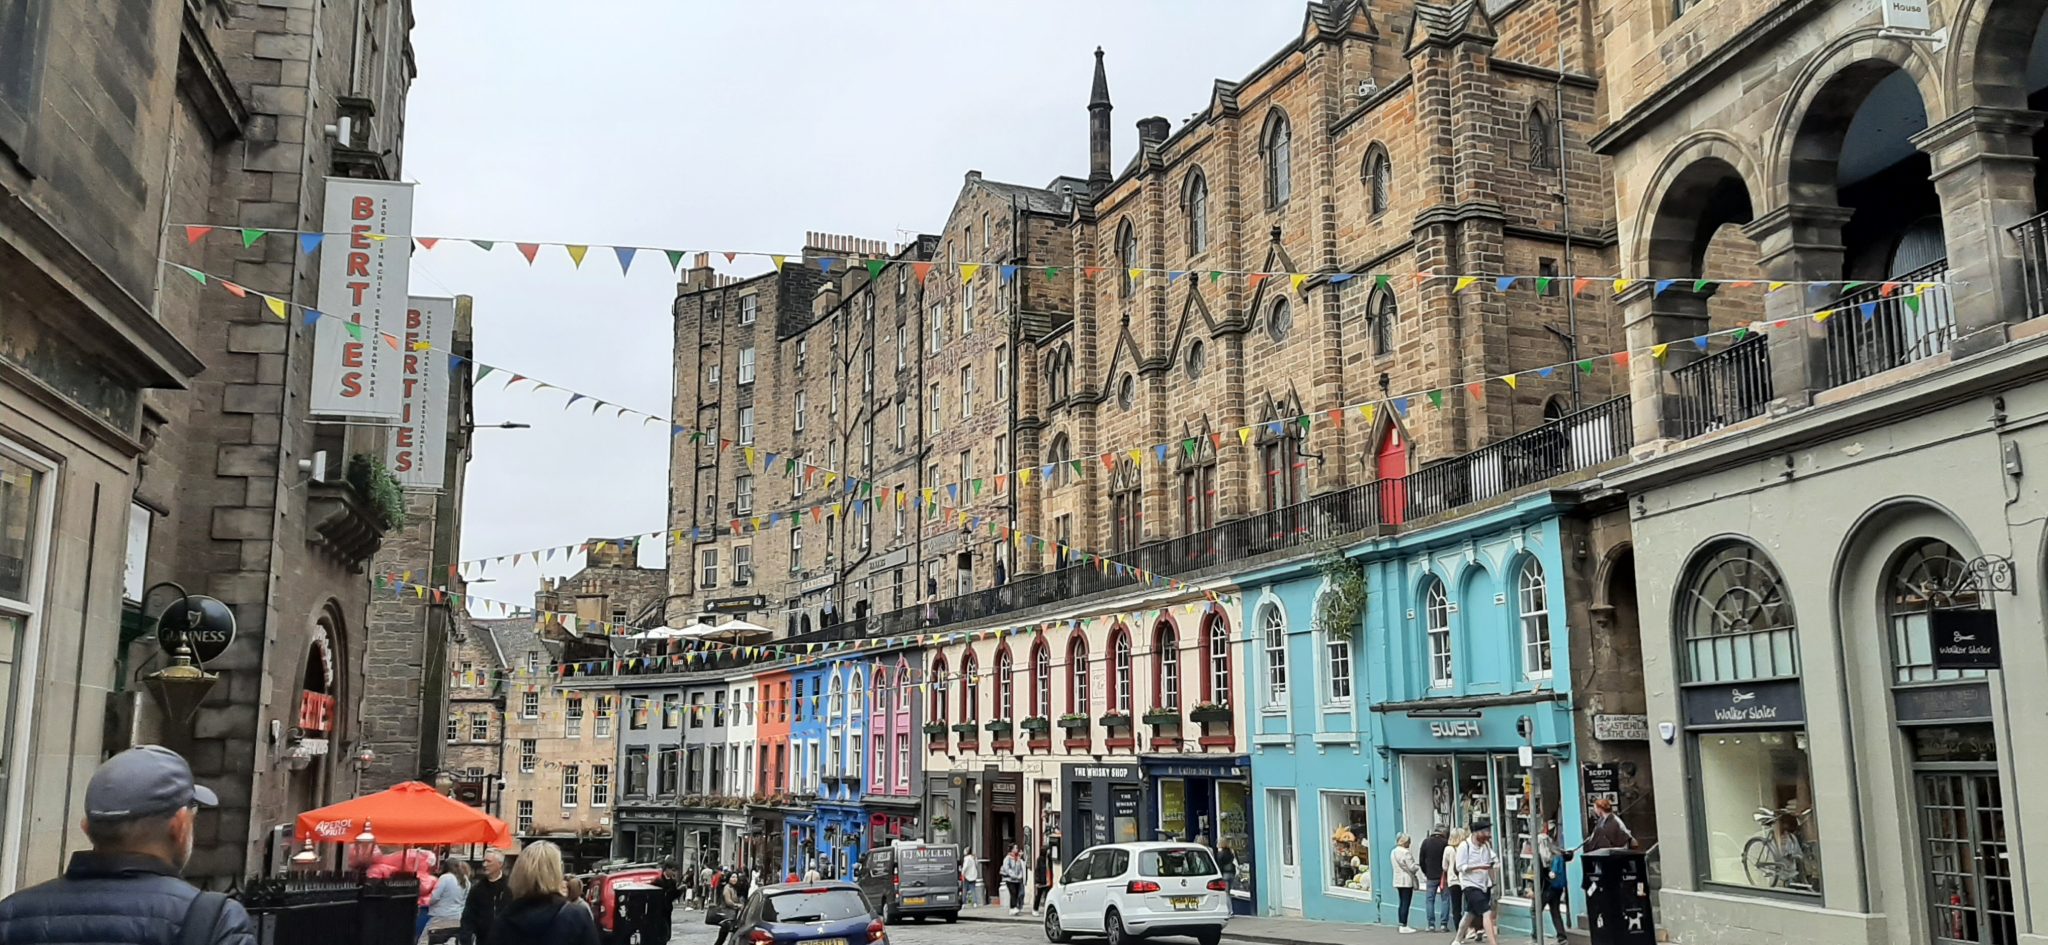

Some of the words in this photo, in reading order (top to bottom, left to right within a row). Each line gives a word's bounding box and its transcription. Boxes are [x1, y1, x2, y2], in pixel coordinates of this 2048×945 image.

[1893, 2, 1921, 12] House
[371, 309, 380, 370] RESTAURANT
[395, 309, 421, 472] BERTIES
[1939, 645, 1967, 654] Walker
[1968, 645, 1991, 654] Slater
[1714, 706, 1748, 720] Walker
[1749, 705, 1777, 719] Slater
[1430, 720, 1480, 736] SWISH
[1074, 767, 1086, 777] THE
[1087, 767, 1110, 778] WHISKY
[1111, 768, 1128, 777] SHOP
[916, 849, 952, 858] MELLIS
